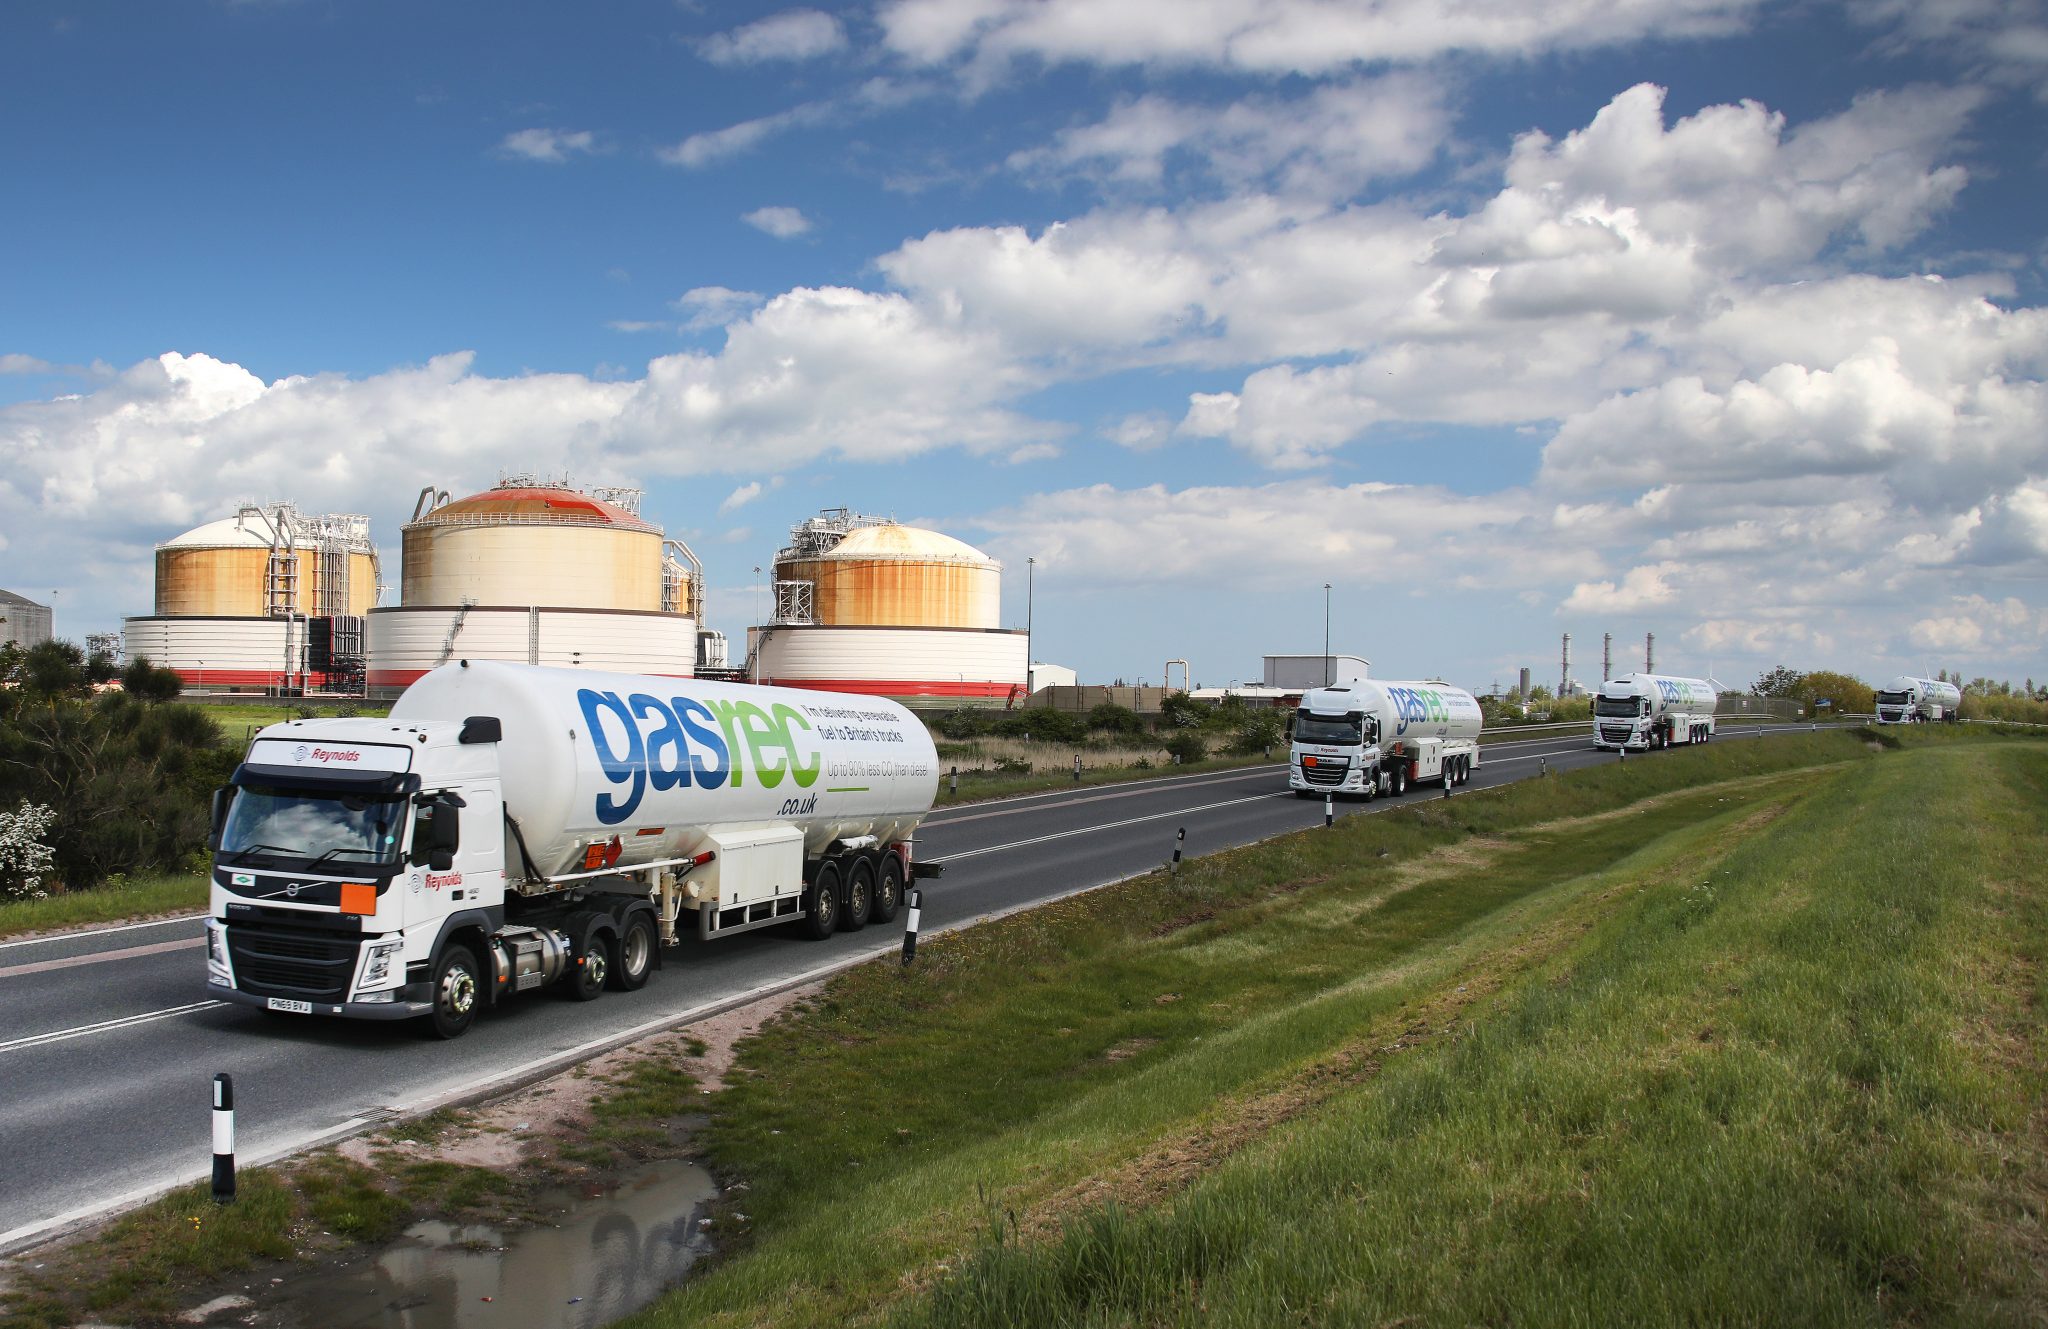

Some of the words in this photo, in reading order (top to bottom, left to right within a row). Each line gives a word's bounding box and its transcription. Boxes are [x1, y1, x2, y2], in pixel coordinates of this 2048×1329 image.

[800, 704, 820, 719] I'm
[819, 706, 863, 722] delivering
[860, 710, 900, 722] renewable
[1388, 687, 1448, 735] gasrec
[817, 724, 838, 740] fuel
[835, 726, 847, 740] to
[844, 726, 880, 741] Britain's
[878, 728, 904, 742] trucks
[311, 748, 360, 762] Reynolds
[577, 688, 820, 824] gasrec
[827, 760, 838, 780] Up
[839, 761, 848, 776] to
[848, 760, 865, 777] 90%
[866, 761, 880, 777] less
[895, 761, 909, 777] than
[910, 761, 928, 777] diesel
[776, 792, 817, 816] .co.uk
[425, 871, 462, 891] Reynolds
